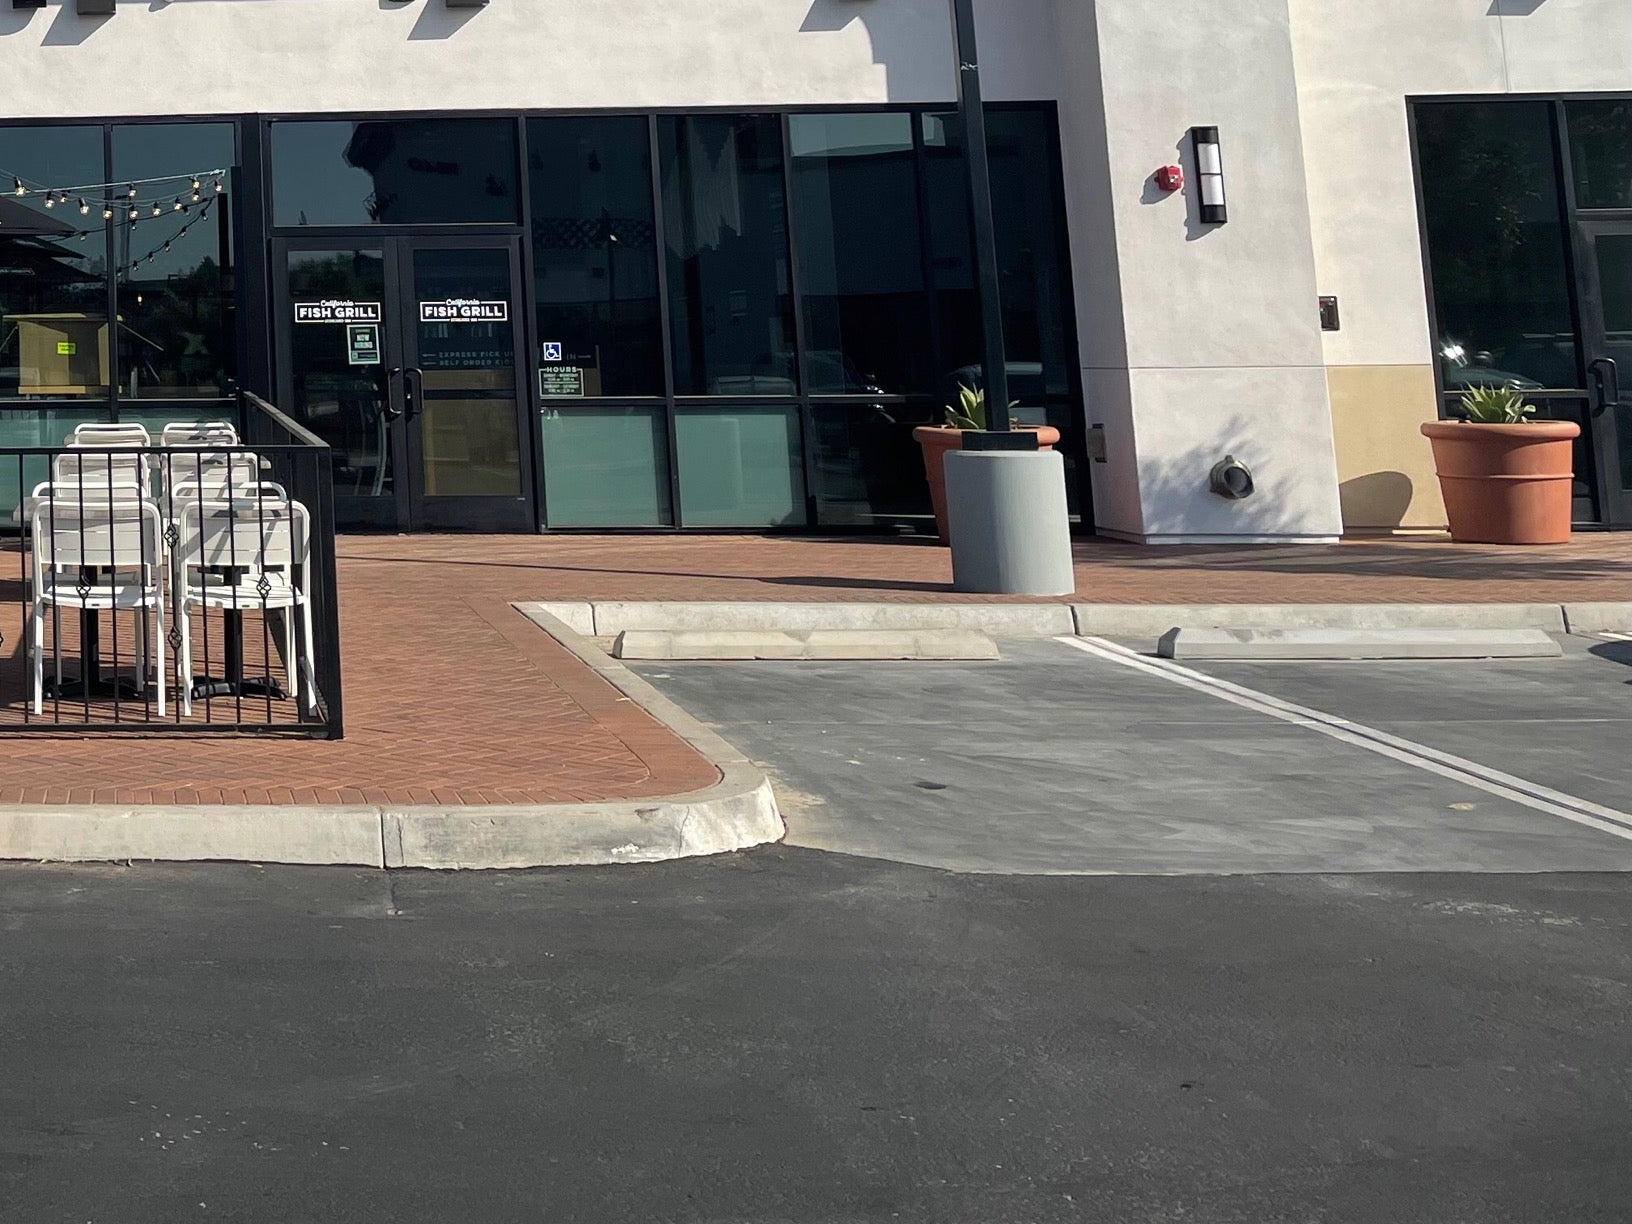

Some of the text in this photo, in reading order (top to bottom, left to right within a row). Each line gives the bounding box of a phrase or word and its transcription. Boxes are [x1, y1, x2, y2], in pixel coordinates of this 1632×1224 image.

[299, 306, 377, 318] FISH GRILL
[424, 305, 503, 317] FISH GRILL
